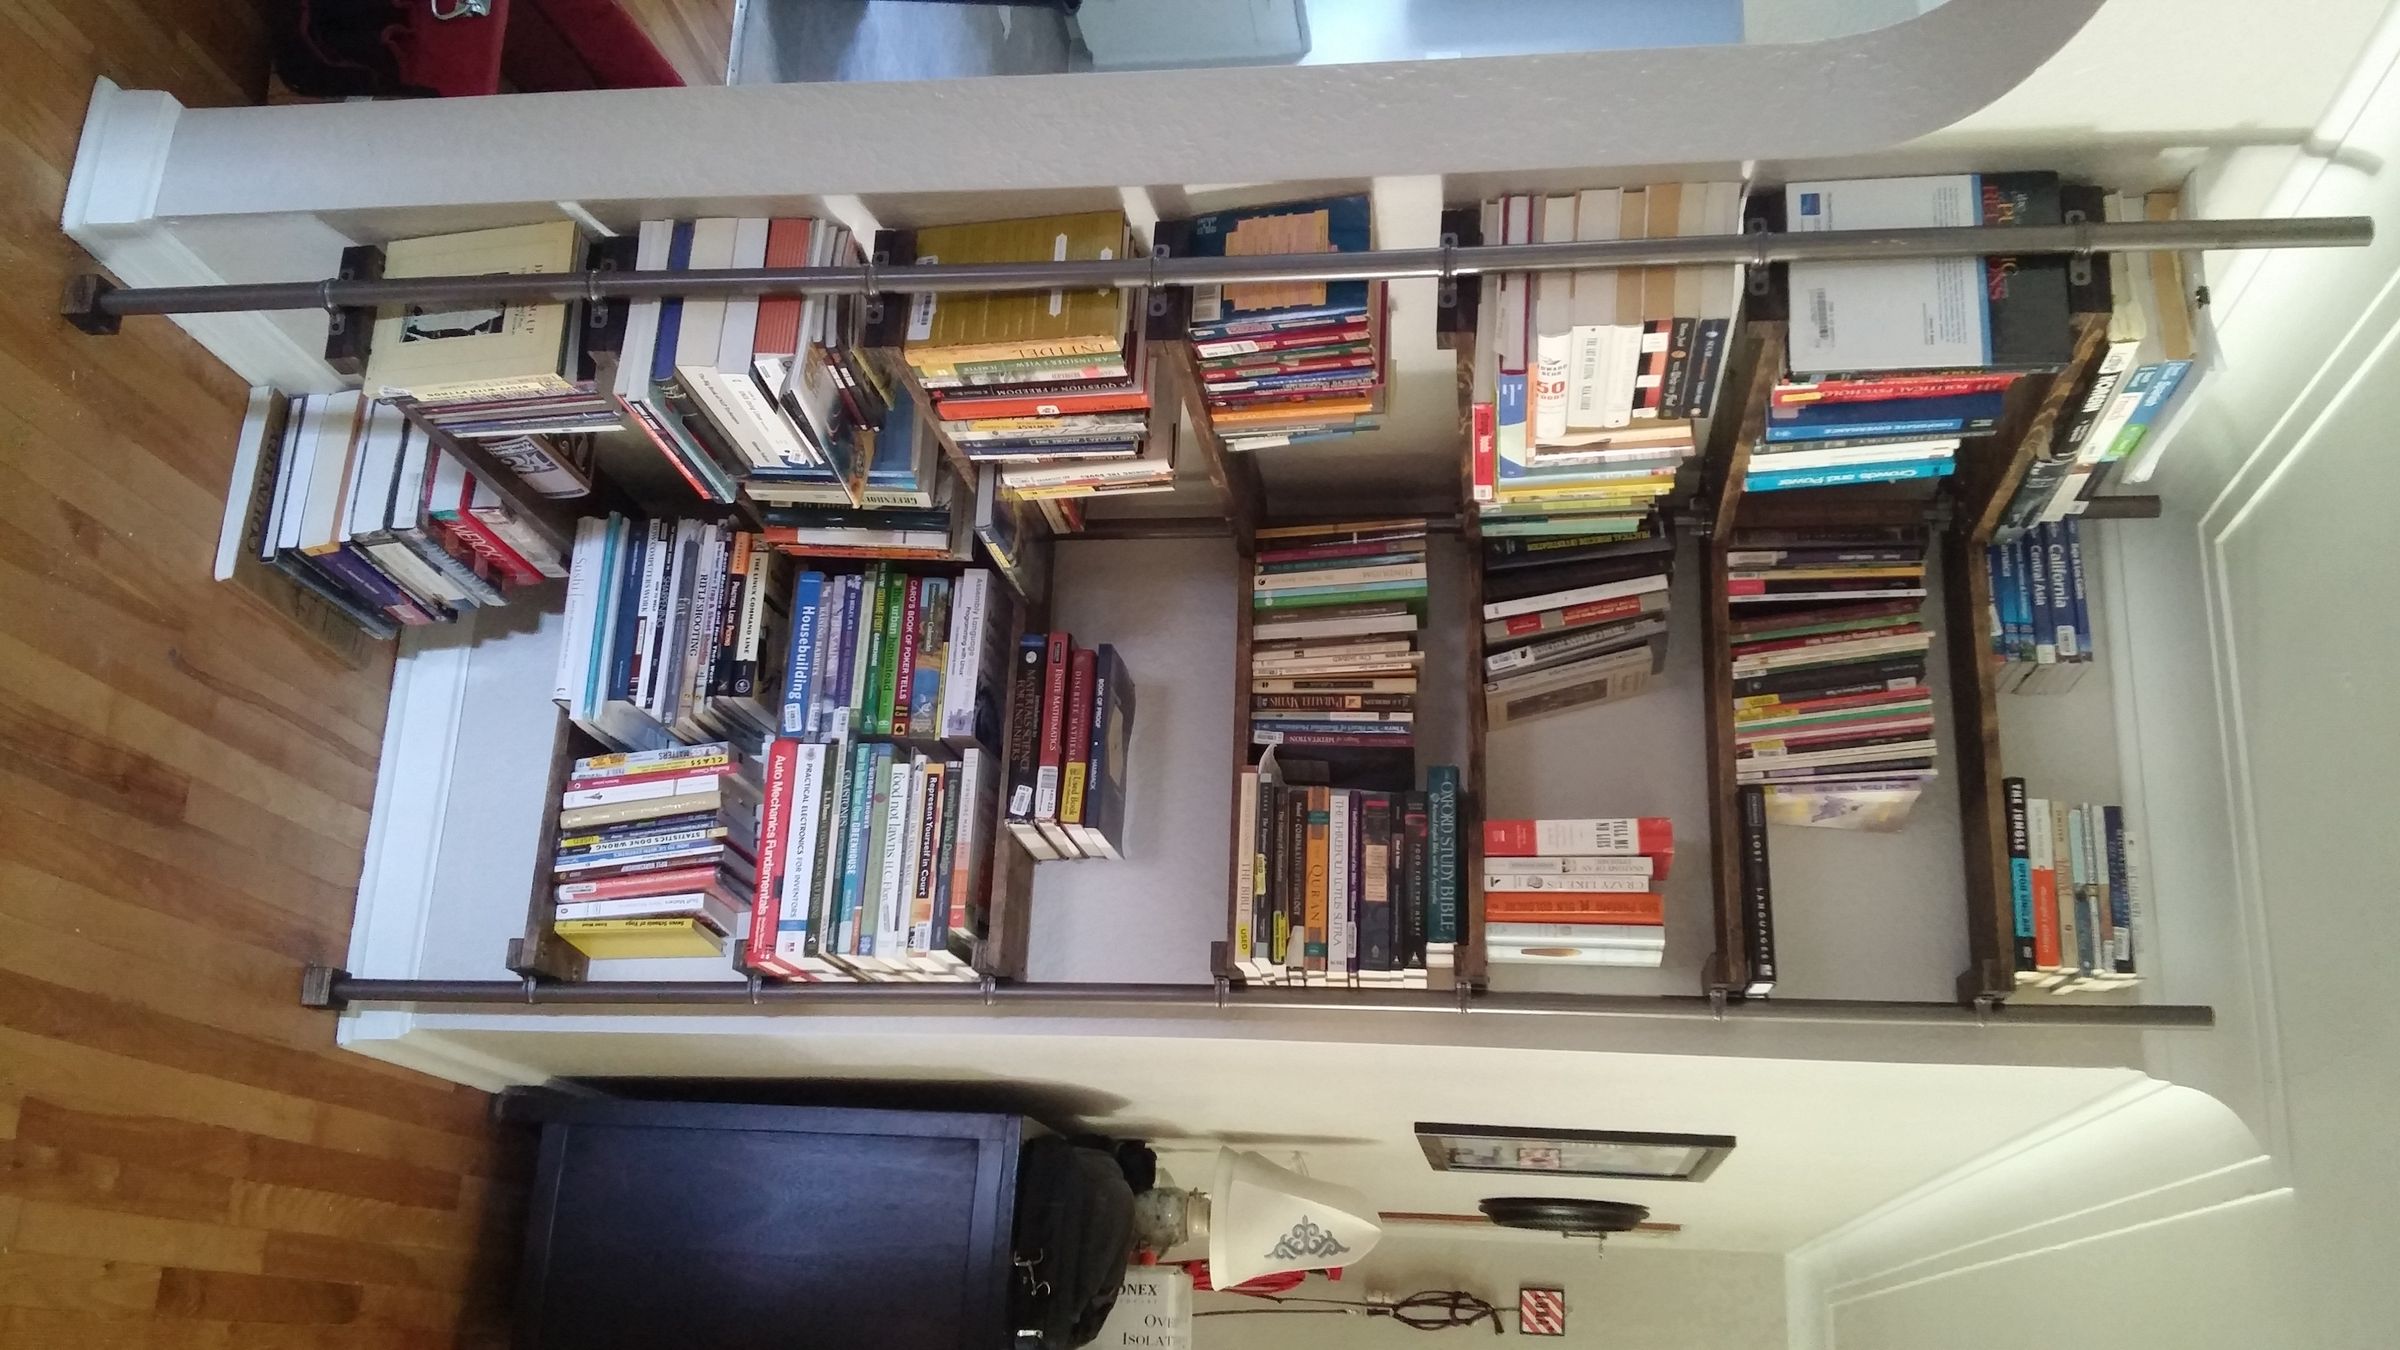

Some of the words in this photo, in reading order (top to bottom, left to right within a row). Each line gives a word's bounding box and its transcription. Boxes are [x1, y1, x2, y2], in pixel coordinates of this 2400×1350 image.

[1011, 343, 1105, 359] INFIDEL
[1016, 359, 1043, 368] VIEW
[427, 390, 466, 398] PYTHON
[996, 386, 1049, 397] FREEDOM
[1061, 382, 1117, 393] QUESTION
[1536, 381, 1565, 394] 50
[1820, 387, 1894, 398] PSYCHOLO
[1899, 383, 1969, 393] POLITICAL
[1824, 424, 1892, 435] GOVERNANCE
[1778, 475, 1824, 488] Power
[1826, 473, 1855, 483] and
[1859, 468, 1918, 481] Crowds
[859, 494, 918, 506] GREENHOU
[452, 524, 495, 558] MERCK
[650, 522, 659, 539] HOW
[1613, 530, 1651, 541] PRACTICAL
[720, 552, 729, 572] Basic
[2000, 544, 2012, 577] amaica
[2071, 543, 2082, 558] Baja
[571, 557, 587, 591] Sushi
[643, 540, 657, 589] COMPUTERS
[753, 558, 761, 572] THE
[2030, 545, 2044, 582] Central
[2073, 565, 2083, 577] Los
[750, 572, 760, 596] LINUX
[878, 572, 887, 587] NEW
[2048, 544, 2069, 608] California
[697, 574, 709, 602] RIFLE
[709, 586, 718, 602] Trap
[717, 573, 727, 610] Machines
[728, 581, 740, 608] PRACTICAL
[892, 586, 904, 603] the
[908, 580, 919, 609] CARO'S
[972, 578, 983, 615] Assembly
[2033, 583, 2047, 606] Asia
[640, 589, 651, 613] WORK
[656, 576, 671, 629] SHARPENING
[676, 597, 691, 617] fat
[708, 602, 716, 610] &
[875, 588, 887, 616] SQUARE
[705, 610, 715, 632] Skeet
[715, 610, 723, 625] and
[745, 597, 756, 636] COMMAND
[815, 606, 827, 640] RAISING
[872, 616, 884, 632] FOOT
[889, 605, 901, 635] urban
[905, 610, 915, 633] BOOK
[961, 606, 972, 647] Programming
[689, 604, 705, 658] SHOOTING
[712, 626, 721, 644] How
[904, 633, 913, 646] OF
[925, 620, 935, 653] Colorado
[967, 616, 979, 657] Language
[709, 644, 719, 664] They
[743, 636, 752, 655] LINE
[789, 605, 816, 700] Housebuilding
[959, 647, 968, 660] with
[812, 640, 823, 677] RABBITS
[883, 636, 899, 692] homestead
[902, 646, 912, 674] POKER
[708, 665, 716, 685] Work
[1053, 668, 1065, 693] FINITE
[899, 674, 909, 700] TELLS
[1016, 679, 1026, 697] FOR
[1023, 669, 1037, 727] MATERIALS
[1072, 670, 1082, 715] DISCRETE
[1097, 678, 1105, 696] BOOK
[1096, 697, 1104, 706] OF
[1270, 696, 1299, 709] MYTHS
[1302, 696, 1344, 709] PARALLEL
[1049, 695, 1063, 751] MATHEMATICS
[1095, 706, 1103, 728] PROOF
[1011, 698, 1024, 761] ENGINEERS
[1068, 717, 1079, 762] MATHEMA
[1289, 736, 1335, 744] MEDITATION
[658, 750, 690, 760] MATTERS
[690, 756, 724, 766] CLASS
[1020, 728, 1032, 773] SCIENCE
[774, 755, 786, 780] Auto
[801, 763, 814, 803] PRACTICAL
[867, 766, 875, 800] OUTDOOR
[890, 771, 906, 799] food
[1071, 776, 1082, 795] Used
[2011, 784, 2023, 805] THE
[839, 769, 853, 828] GEMSTONES
[925, 777, 938, 821] Represent
[943, 779, 958, 818] Learning
[962, 779, 972, 817] FURNITURE
[1069, 796, 1080, 816] Book
[1334, 800, 1345, 819] THE
[1439, 781, 1455, 834] OXFORD
[766, 781, 783, 839] Mechanics
[863, 801, 873, 829] SHOWER
[889, 800, 901, 821] not
[654, 831, 701, 842] STATISTICS
[797, 805, 810, 855] ELECTRONICS
[942, 819, 954, 838] Web
[1595, 822, 1609, 832] NO
[1613, 820, 1628, 838] TELL
[2012, 808, 2026, 851] JUNGLE
[595, 841, 627, 851] WRONG
[628, 838, 652, 846] DONE
[846, 821, 861, 875] GREENHOUSE
[886, 823, 902, 858] lawns
[922, 821, 934, 858] Yourself
[1332, 821, 1345, 875] THREEFOLD
[1596, 833, 1611, 848] LIES
[1614, 840, 1629, 850] ME
[1752, 834, 1763, 863] LOST
[795, 857, 804, 873] FOR
[921, 858, 930, 868] in
[939, 841, 953, 876] Design
[1414, 843, 1422, 866] FOOD
[1438, 836, 1454, 883] STUDY
[757, 839, 780, 916] Fundamentals
[919, 869, 929, 897] Court
[1241, 862, 1250, 882] THE
[1414, 870, 1422, 887] FOR
[2017, 863, 2029, 892] UPTON
[790, 874, 802, 918] INVENTORS
[1307, 864, 1324, 921] QUR'AN
[1332, 877, 1345, 910] LOTUS
[1547, 880, 1564, 890] US
[1567, 880, 1597, 889] LIKE
[1600, 880, 1645, 889] CRAZY
[1239, 885, 1250, 913] BIBLE
[1414, 889, 1422, 906] THE
[1439, 885, 1455, 931] BIBLE
[625, 920, 639, 928] Yoga
[647, 920, 668, 928] Schools
[1756, 887, 1768, 959] LANGUAGES
[2019, 894, 2031, 933] SINCLAIR
[1240, 928, 1248, 950] USED
[1332, 911, 1344, 946] SUTRA
